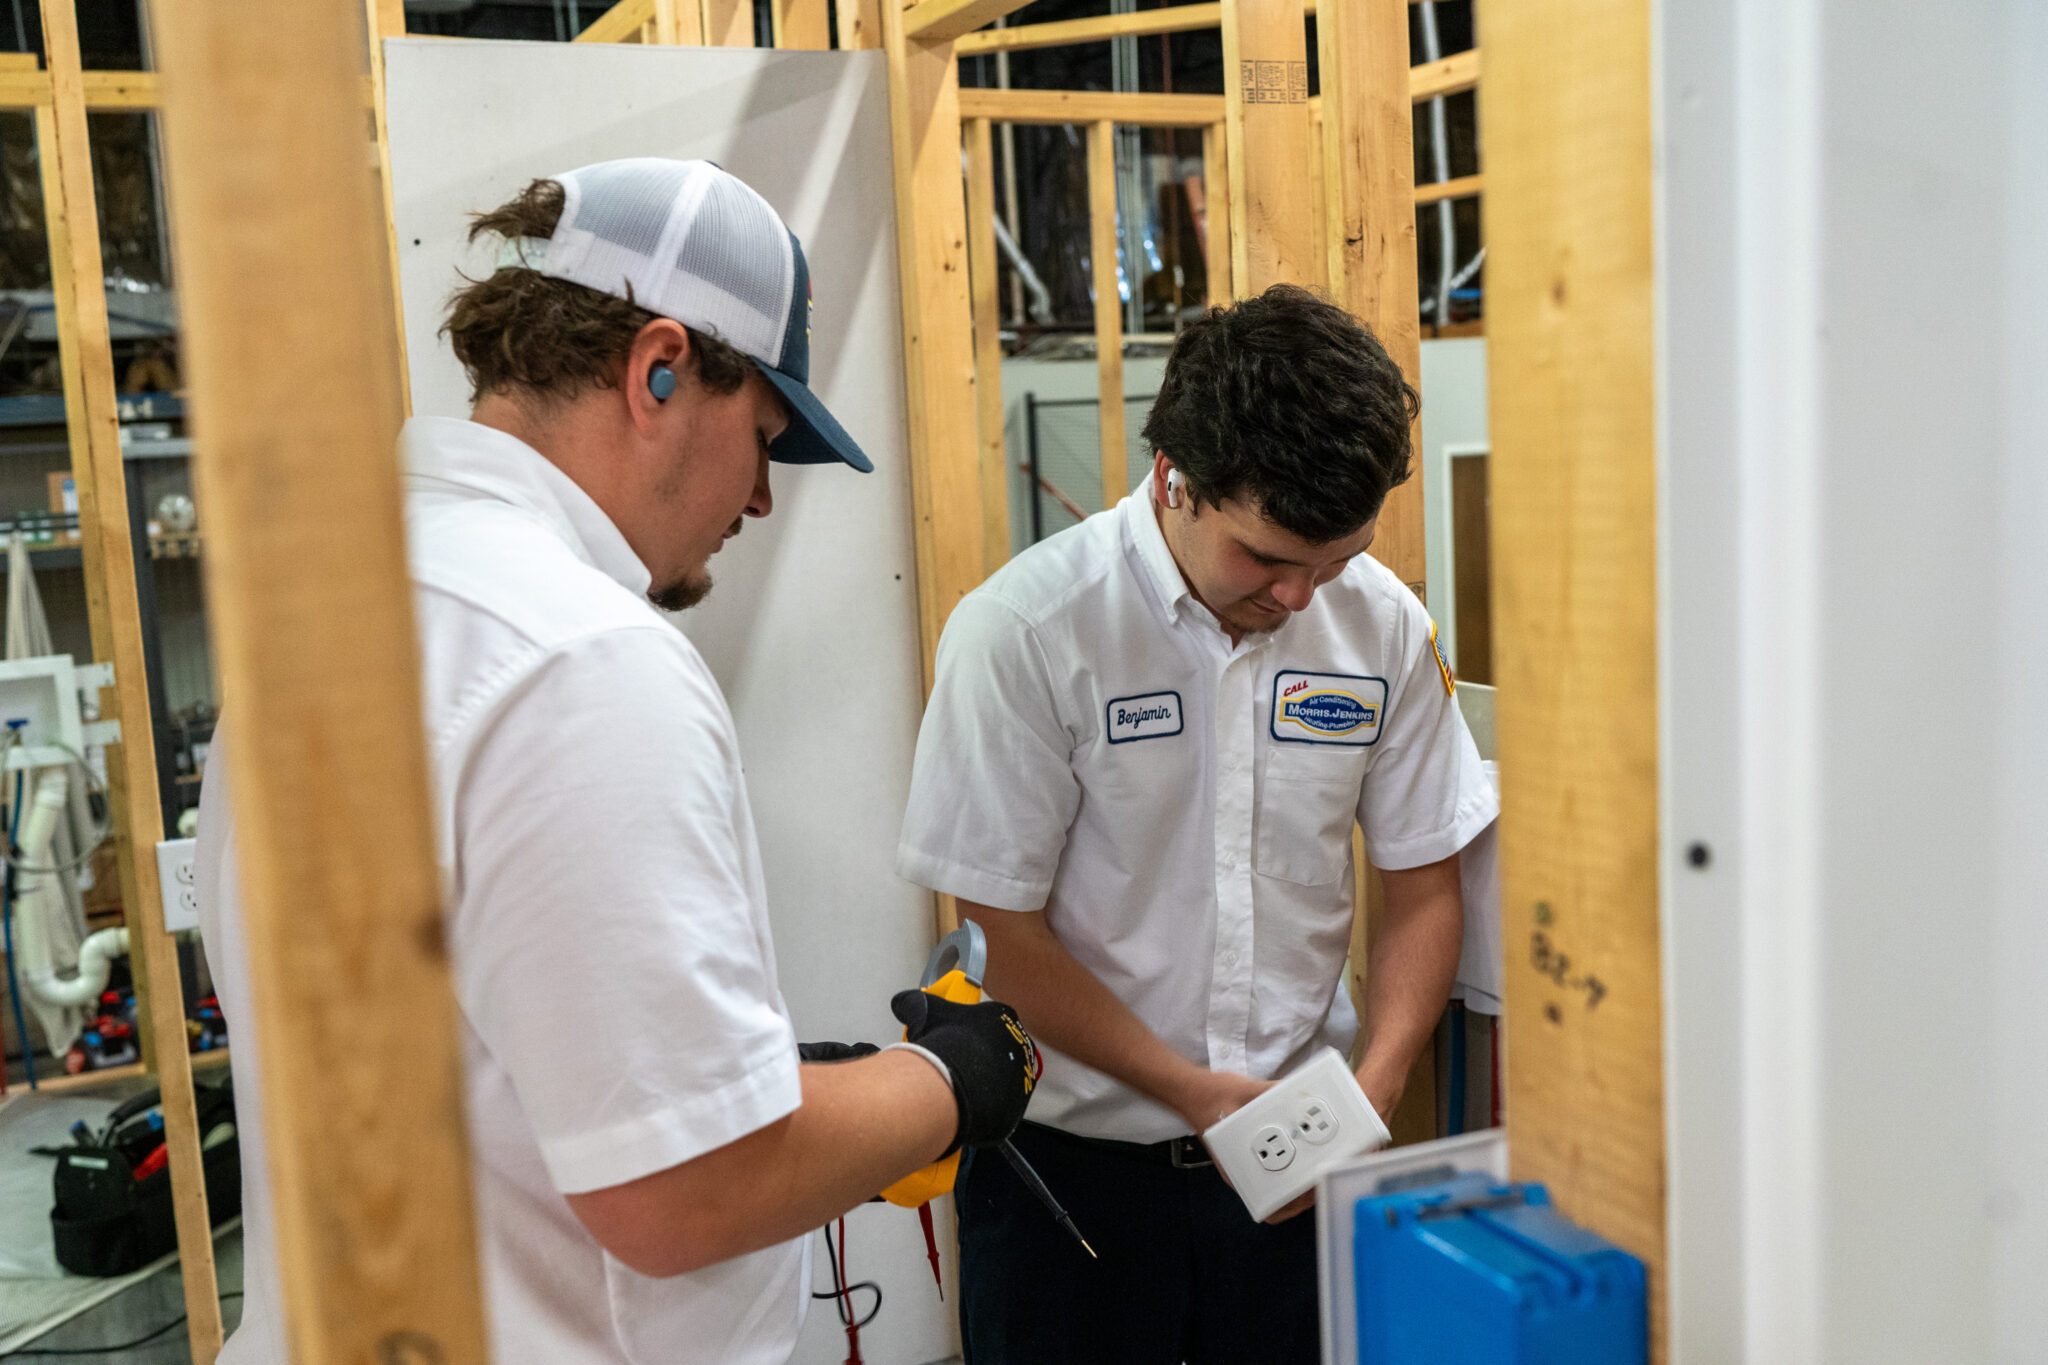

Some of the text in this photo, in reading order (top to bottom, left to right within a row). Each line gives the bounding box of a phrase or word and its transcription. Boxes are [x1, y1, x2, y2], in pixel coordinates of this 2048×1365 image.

[1283, 680, 1309, 697] CALL
[1309, 696, 1357, 710] Air Conditioning
[1117, 705, 1172, 729] Benjamin
